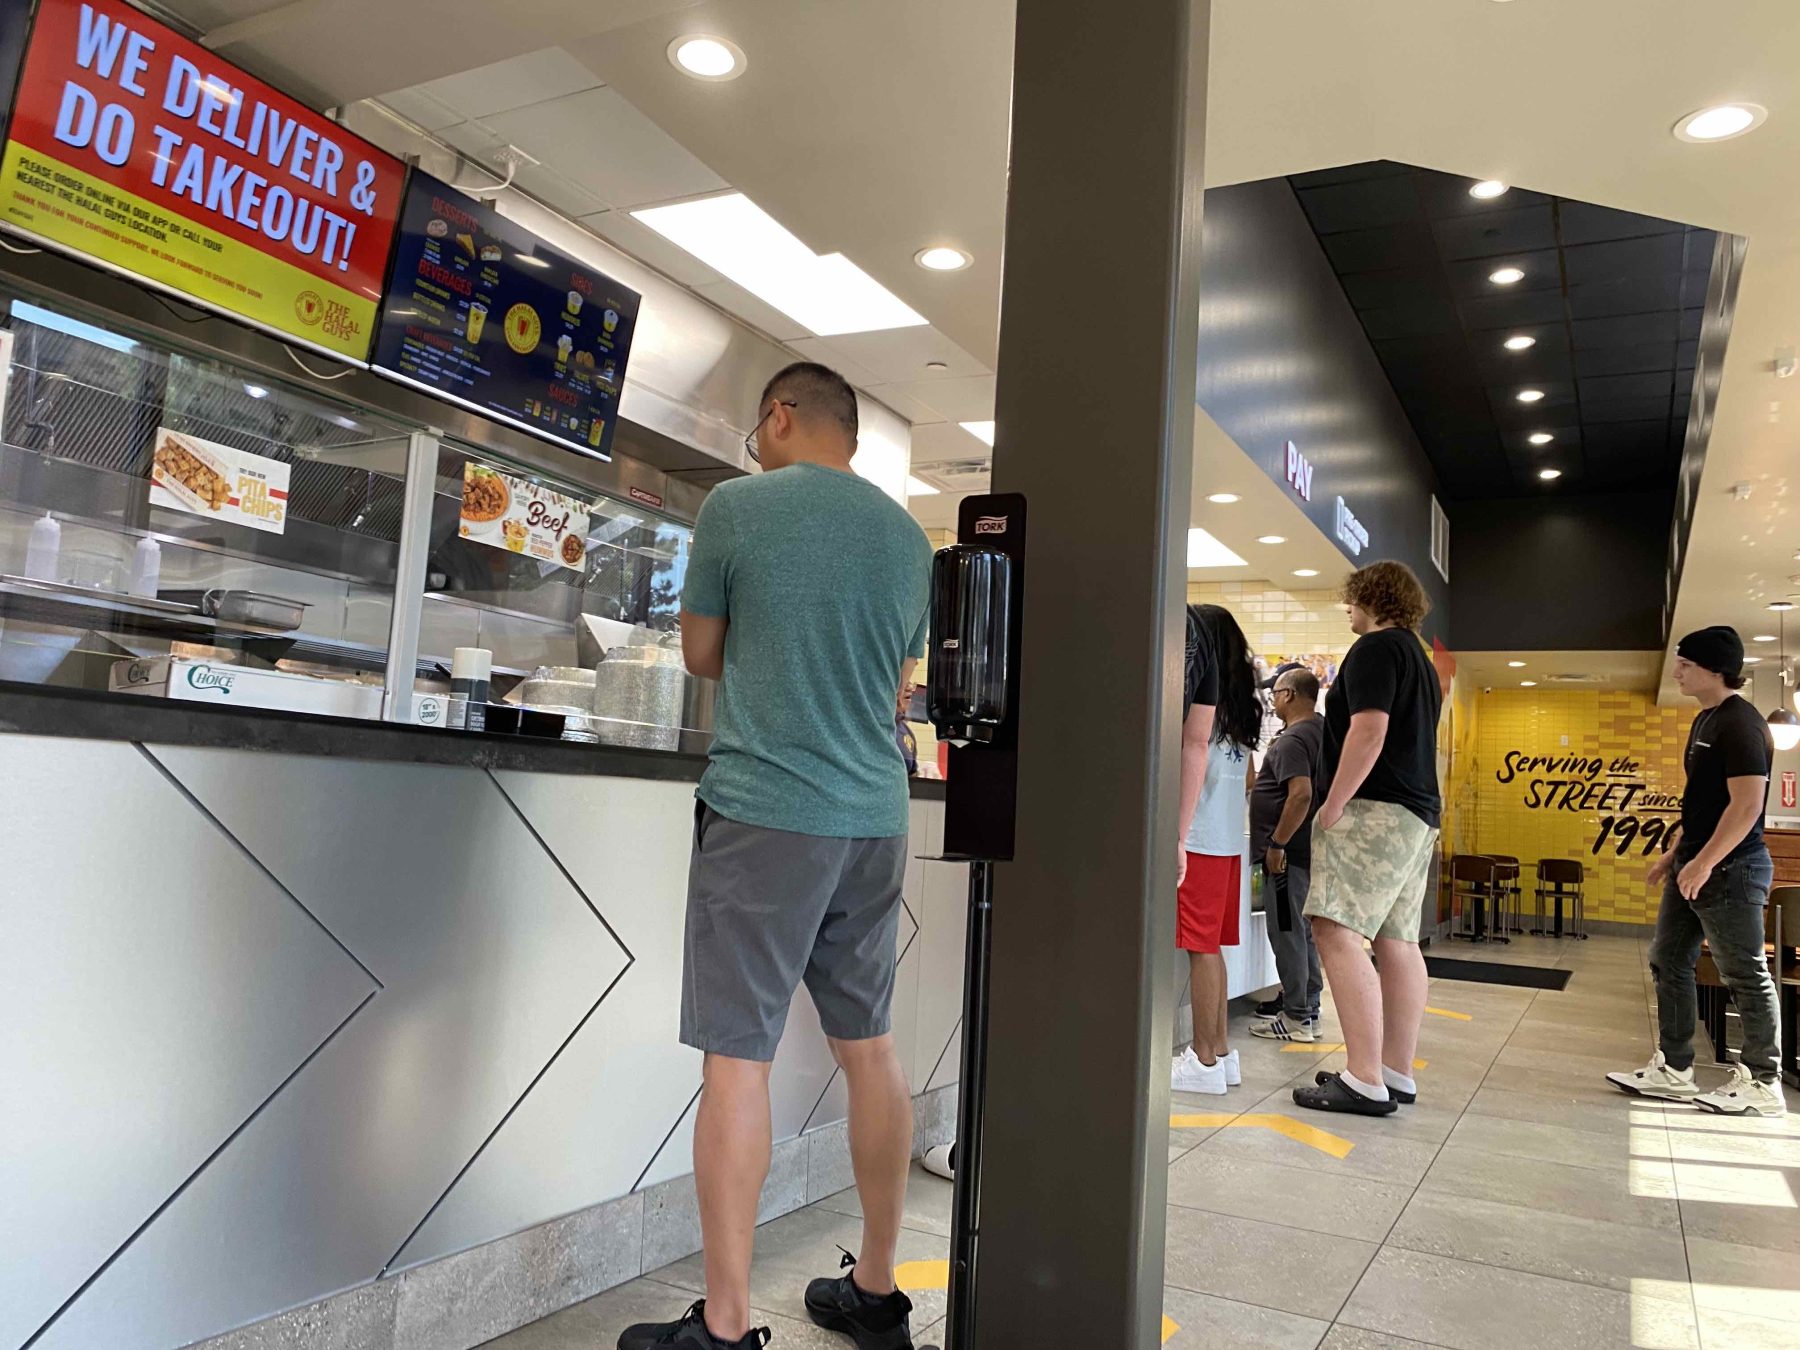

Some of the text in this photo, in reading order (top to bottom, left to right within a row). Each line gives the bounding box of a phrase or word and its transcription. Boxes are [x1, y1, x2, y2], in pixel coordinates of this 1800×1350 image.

[76, 3, 376, 216] WE DELIVER &
[54, 80, 357, 272] DO TAKEOUT!
[16, 170, 56, 194] NEAREST
[57, 187, 74, 202] THE
[75, 196, 102, 215] HALAL
[104, 208, 127, 225] GUYS
[19, 157, 223, 253] PLEASE ORDER ONLINE VIA OUR APP OR CALL YOUR
[418, 259, 473, 296] BEVERAGES
[324, 310, 360, 335] HALAL
[328, 299, 350, 319] THE
[322, 321, 352, 342] GUYS
[236, 474, 268, 498] PITA
[1286, 440, 1313, 502] PAY
[240, 494, 284, 522] CHIPS
[526, 500, 570, 541] Beef
[977, 522, 1005, 532] TORK
[188, 664, 236, 694] CHOICE
[1496, 750, 1640, 783] Serving the
[1524, 778, 1646, 812] STREET
